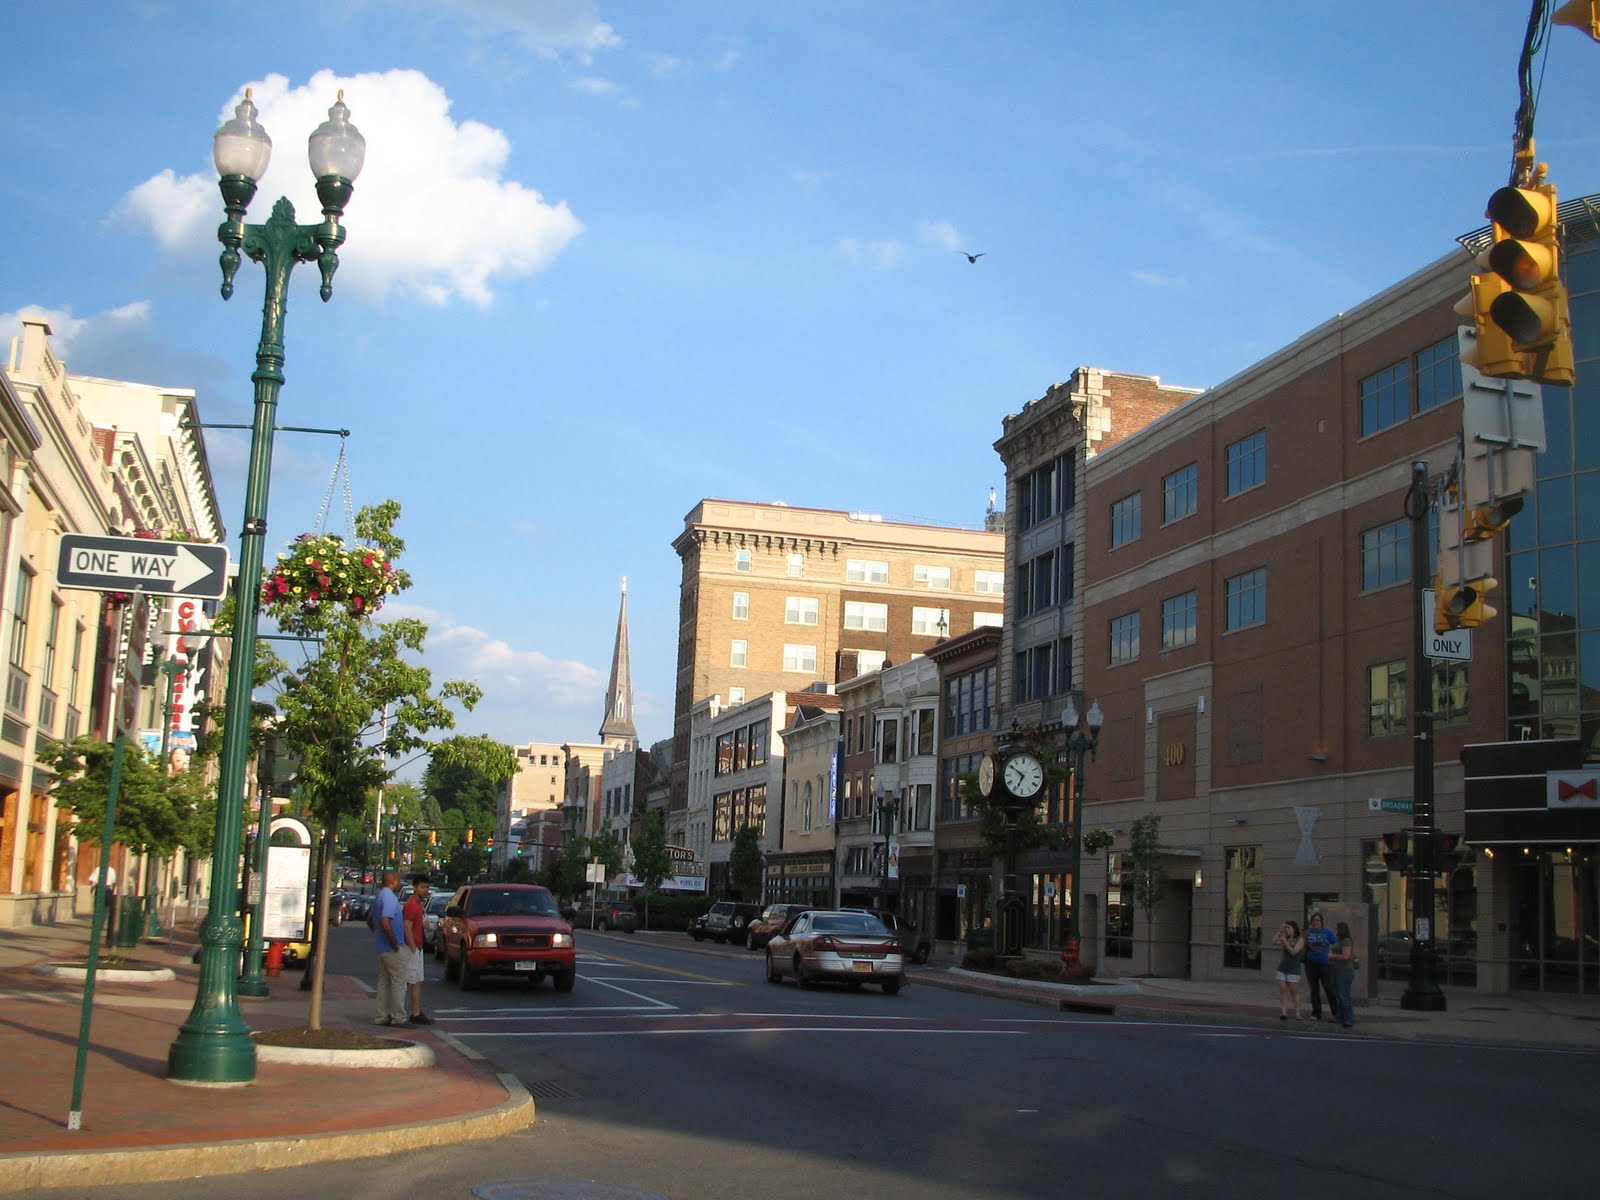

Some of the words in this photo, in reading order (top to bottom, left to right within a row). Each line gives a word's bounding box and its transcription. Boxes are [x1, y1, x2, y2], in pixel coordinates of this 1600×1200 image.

[76, 551, 119, 573] ONE
[131, 555, 175, 577] WAY
[1433, 639, 1462, 653] ONLY
[1382, 801, 1413, 810] BROADWAY
